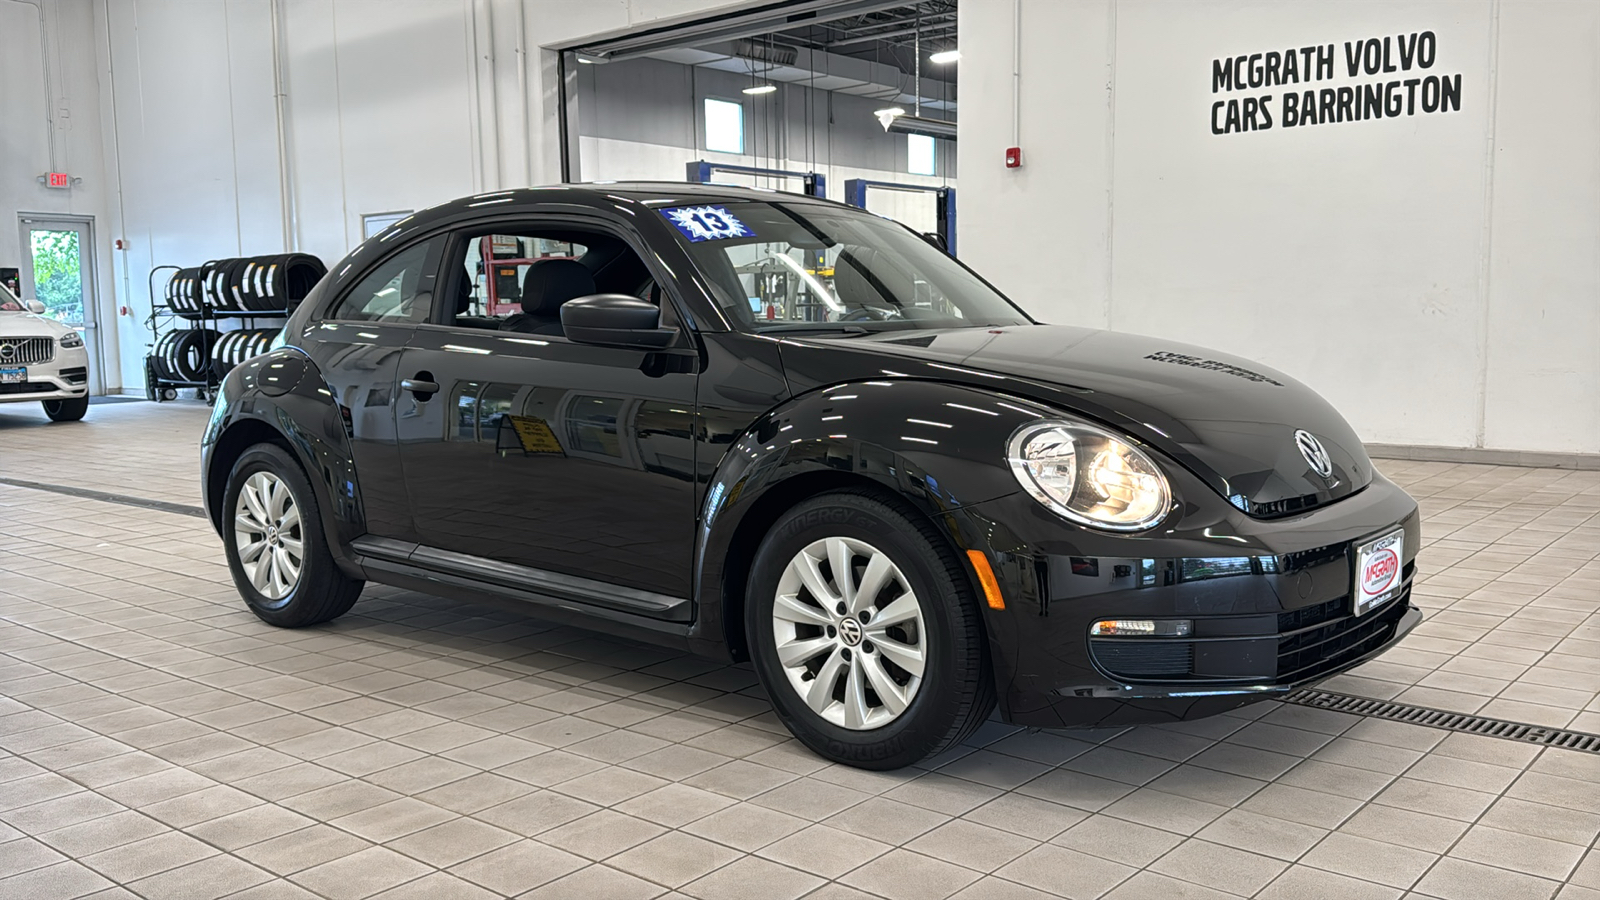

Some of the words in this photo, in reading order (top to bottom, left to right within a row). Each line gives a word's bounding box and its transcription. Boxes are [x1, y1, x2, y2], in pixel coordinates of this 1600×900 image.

[1212, 44, 1334, 93] MCGRATH
[1344, 31, 1436, 77] VOLVO
[1211, 95, 1273, 135] CARS
[1282, 74, 1462, 128] BARRINGTON
[50, 173, 67, 186] EXIT
[690, 212, 730, 232] 13
